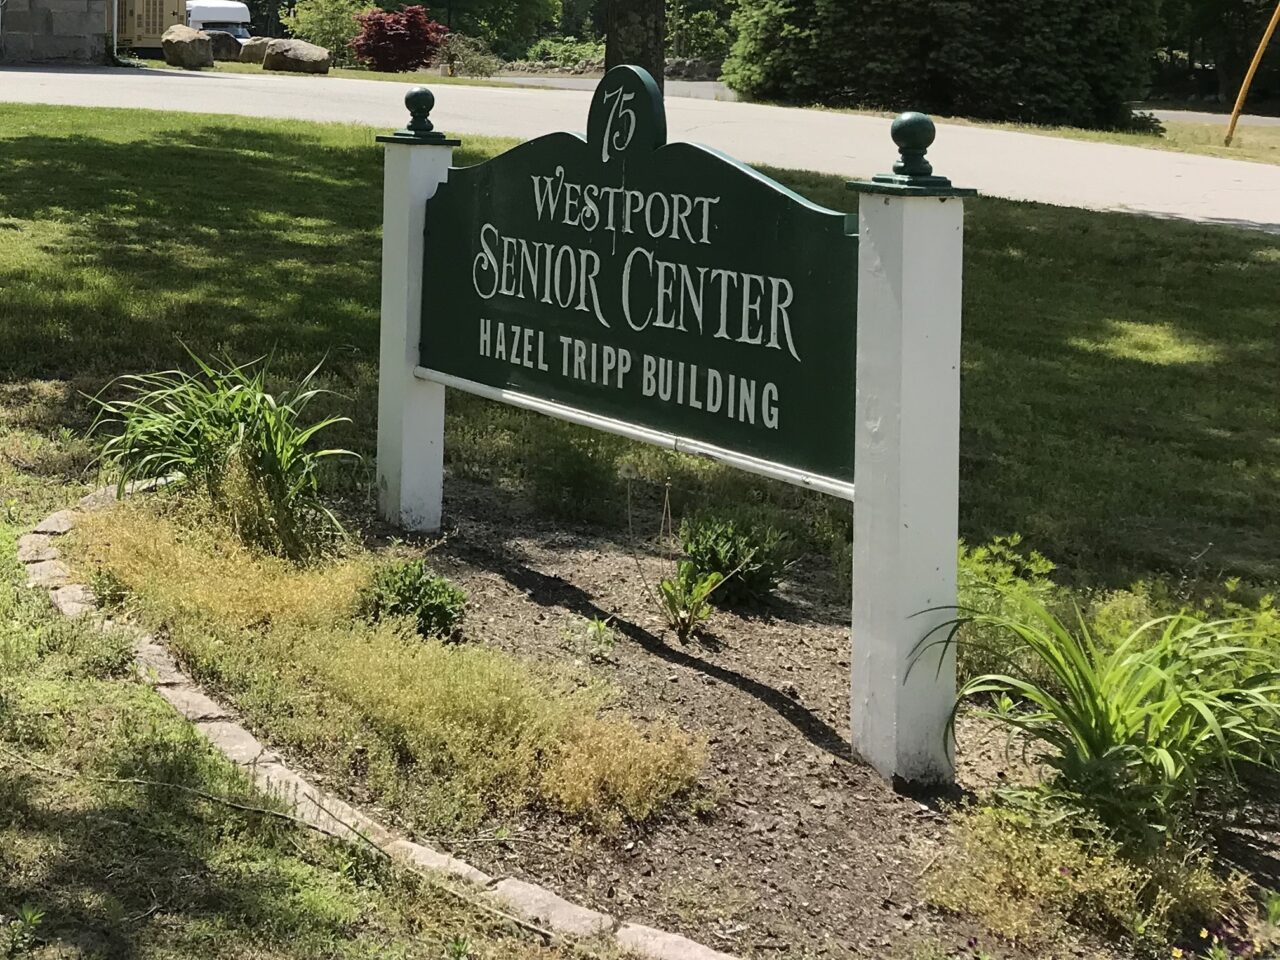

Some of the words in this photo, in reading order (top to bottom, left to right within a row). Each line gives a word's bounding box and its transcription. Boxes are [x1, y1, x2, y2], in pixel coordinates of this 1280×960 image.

[602, 86, 636, 162] 75
[532, 166, 720, 244] WESTPORT
[473, 223, 610, 328] SENIOR
[622, 247, 801, 362] CENTER
[479, 318, 549, 372] HAZEL
[560, 335, 632, 389] TRIPP
[642, 354, 780, 430] BUILDING
